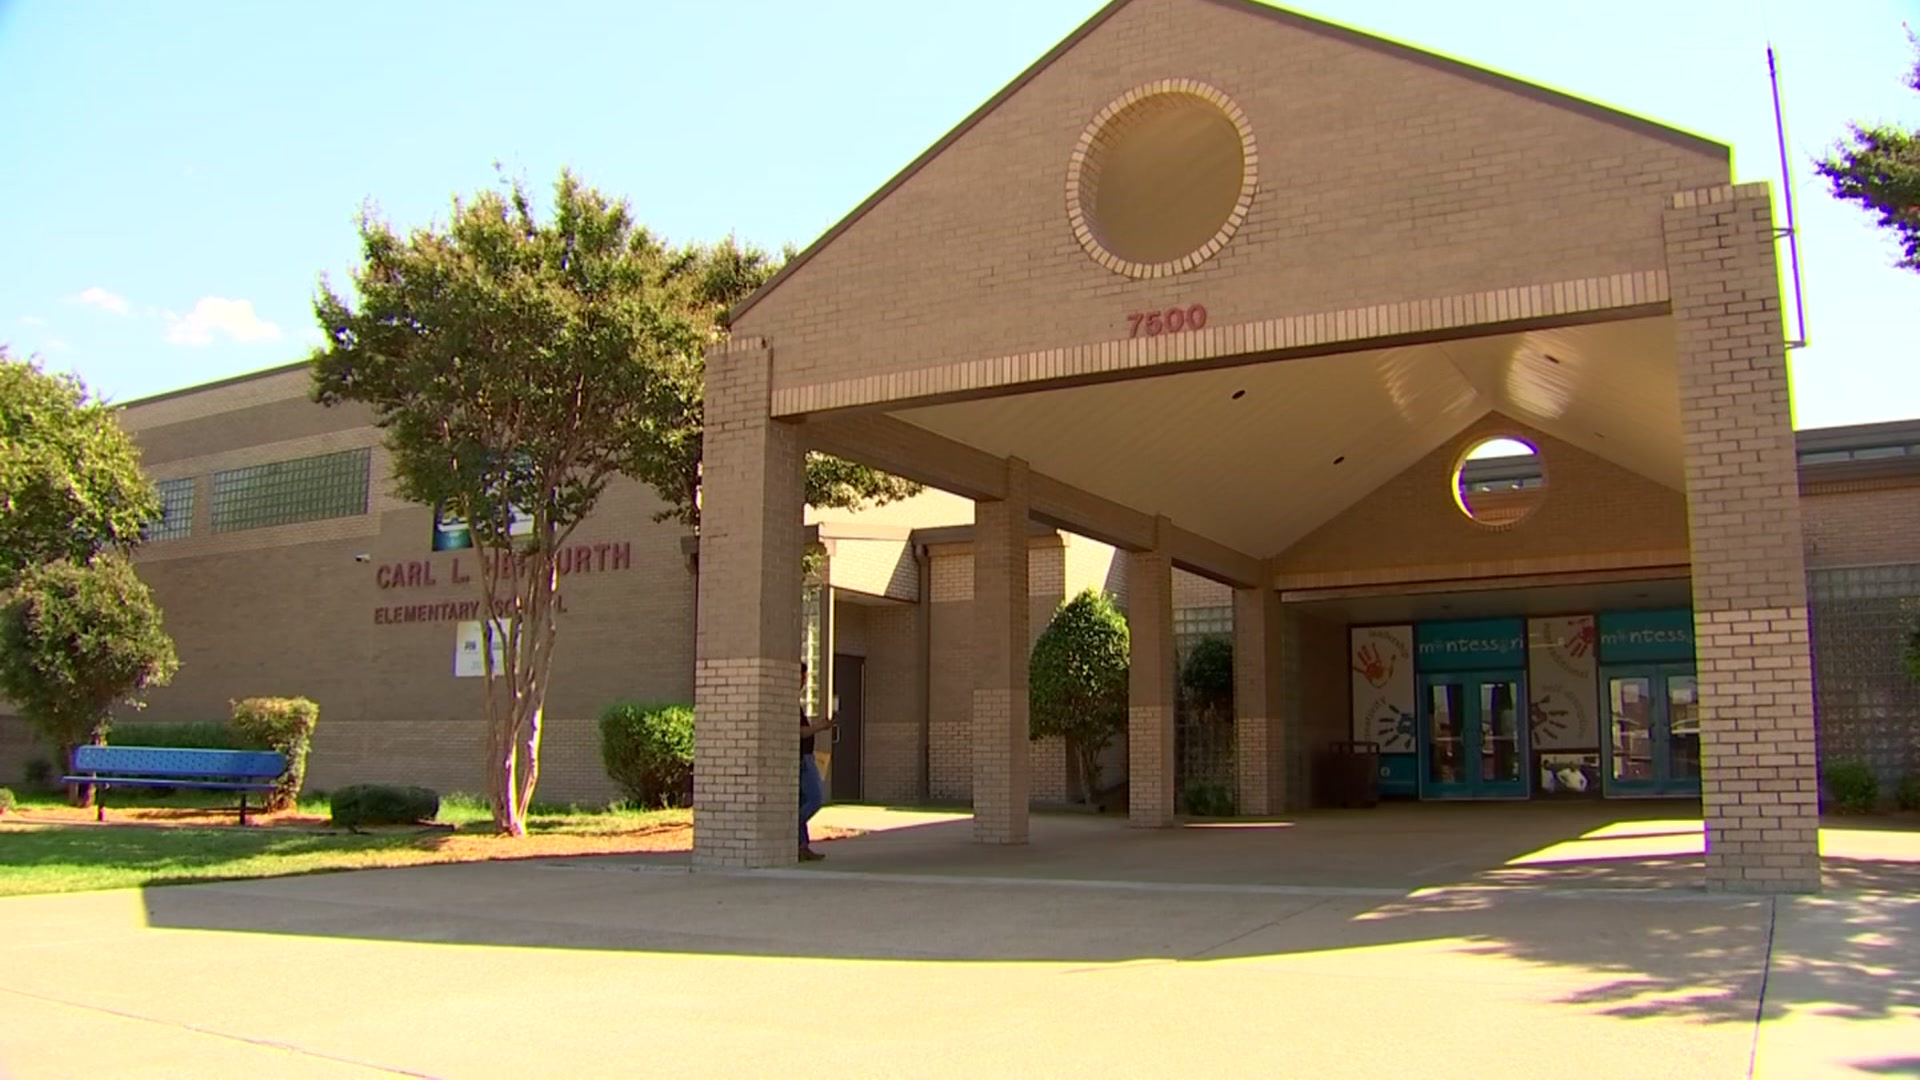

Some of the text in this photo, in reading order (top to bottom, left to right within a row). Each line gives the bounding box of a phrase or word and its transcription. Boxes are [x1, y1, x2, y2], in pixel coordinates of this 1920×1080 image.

[1127, 303, 1207, 339] 7500
[376, 561, 436, 590] CARL
[452, 558, 470, 584] L.
[374, 595, 568, 625] ELEMENTARY SCL
